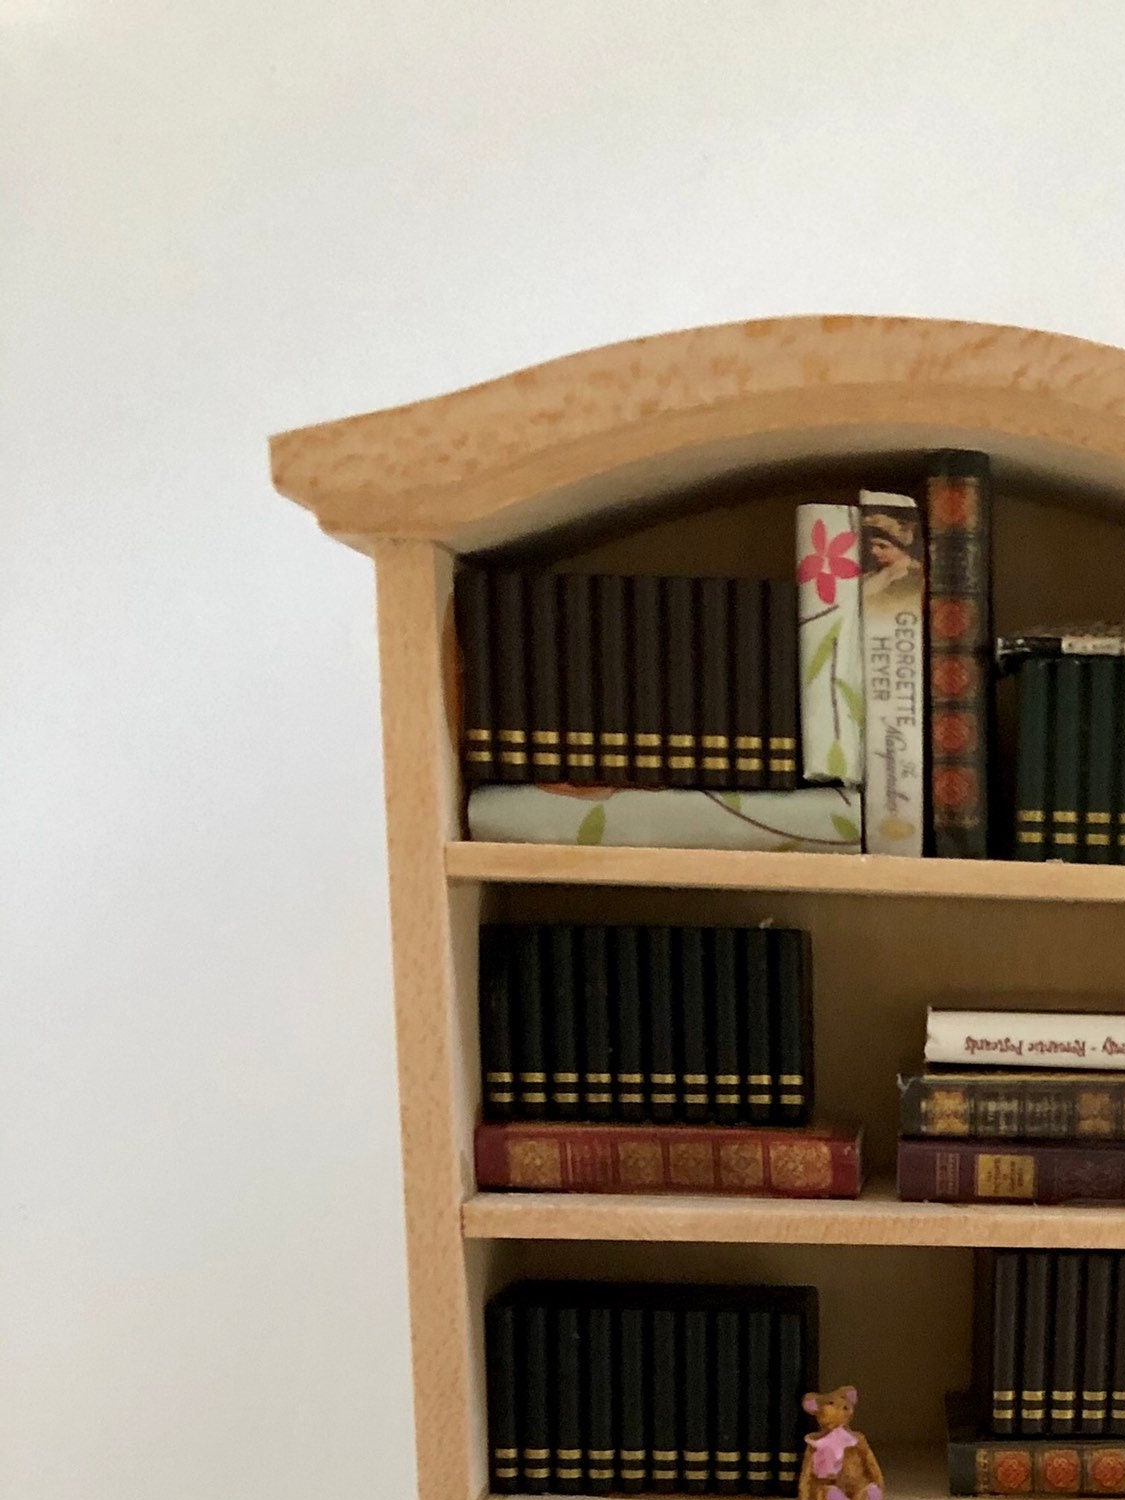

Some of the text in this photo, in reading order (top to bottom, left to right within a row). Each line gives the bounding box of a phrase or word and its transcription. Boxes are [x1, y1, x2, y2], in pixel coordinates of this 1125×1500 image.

[871, 636, 893, 702] HEYER
[894, 611, 918, 727] GEORGETTE
[1028, 1038, 1086, 1058] Romantic
